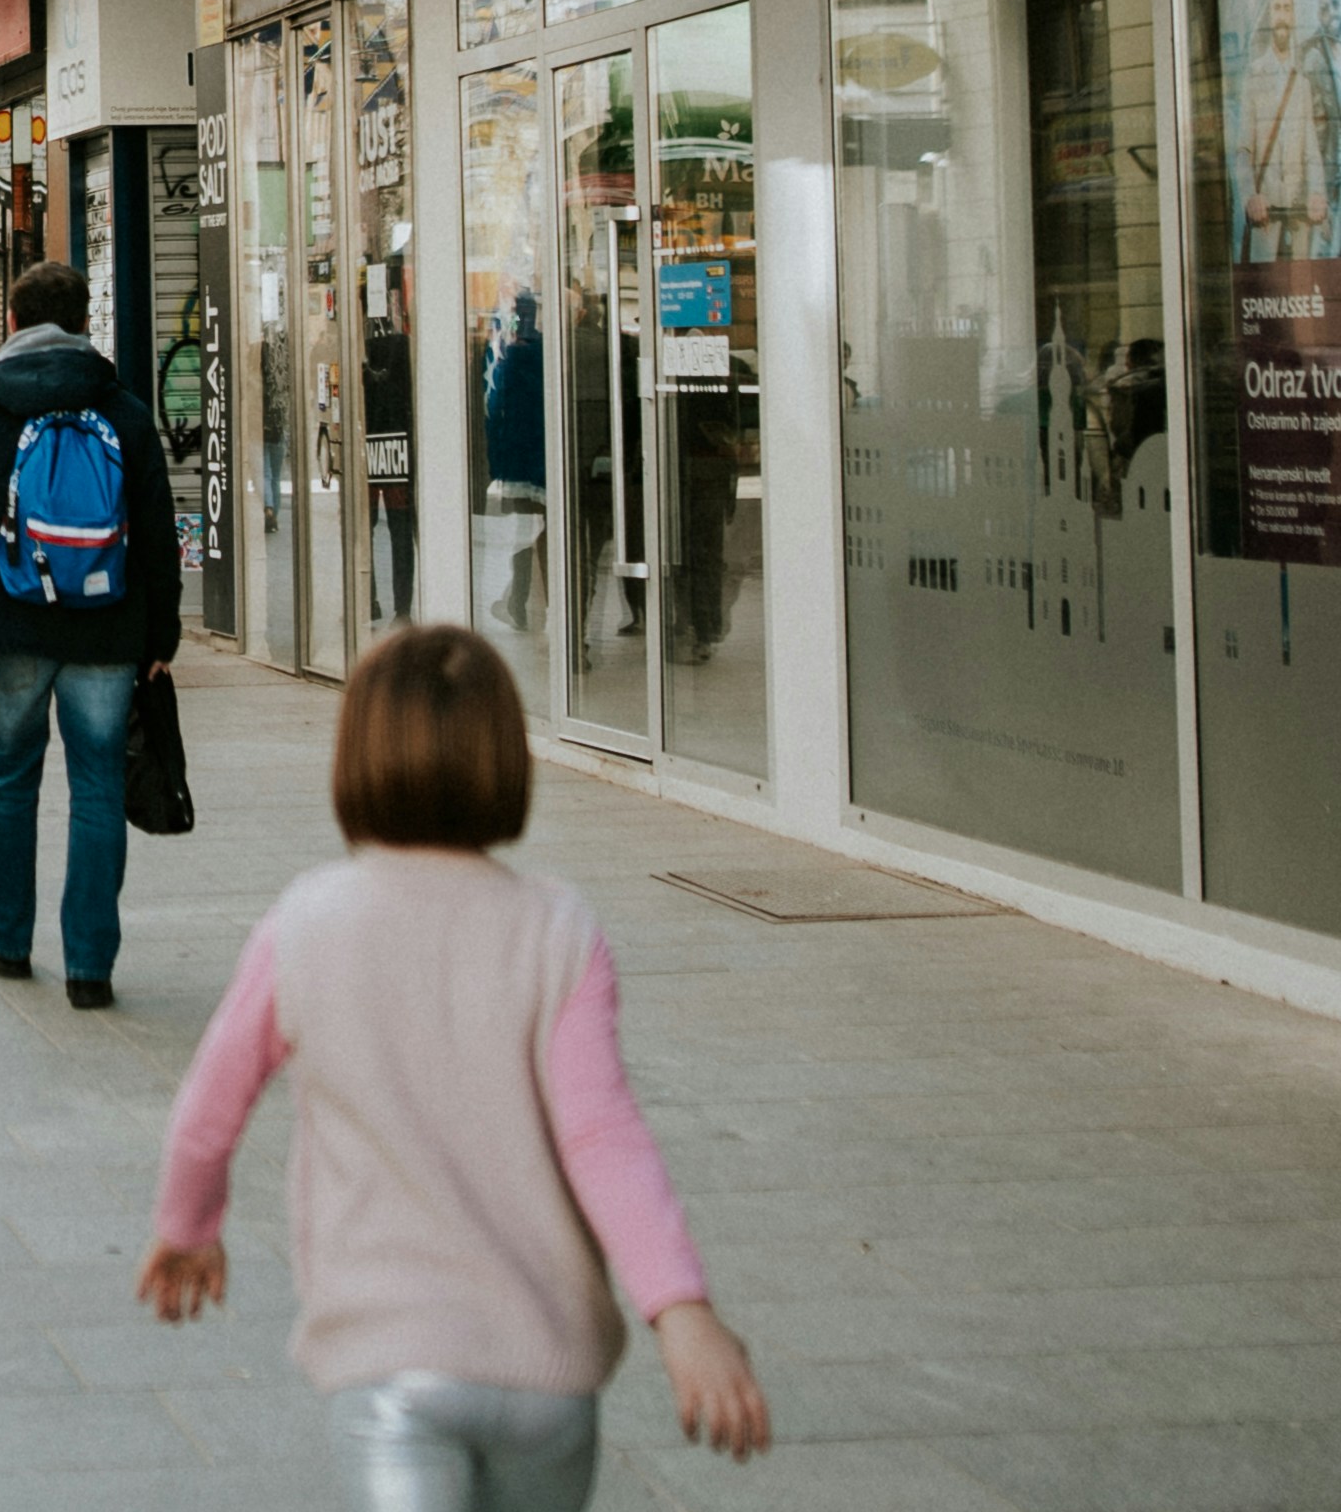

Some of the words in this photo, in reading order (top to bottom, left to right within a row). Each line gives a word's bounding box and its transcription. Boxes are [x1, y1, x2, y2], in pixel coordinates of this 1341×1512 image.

[57, 59, 87, 105] IQOS
[198, 114, 226, 160] POD
[358, 103, 398, 166] JUST
[199, 161, 227, 207] SALT
[1241, 294, 1311, 319] SPARKASSE
[1244, 361, 1308, 399] Odraz
[1247, 411, 1300, 431] Ostvarimo
[365, 439, 409, 476] WATCH
[1249, 465, 1304, 485] Nenamjenski
[1305, 467, 1332, 484] kredit
